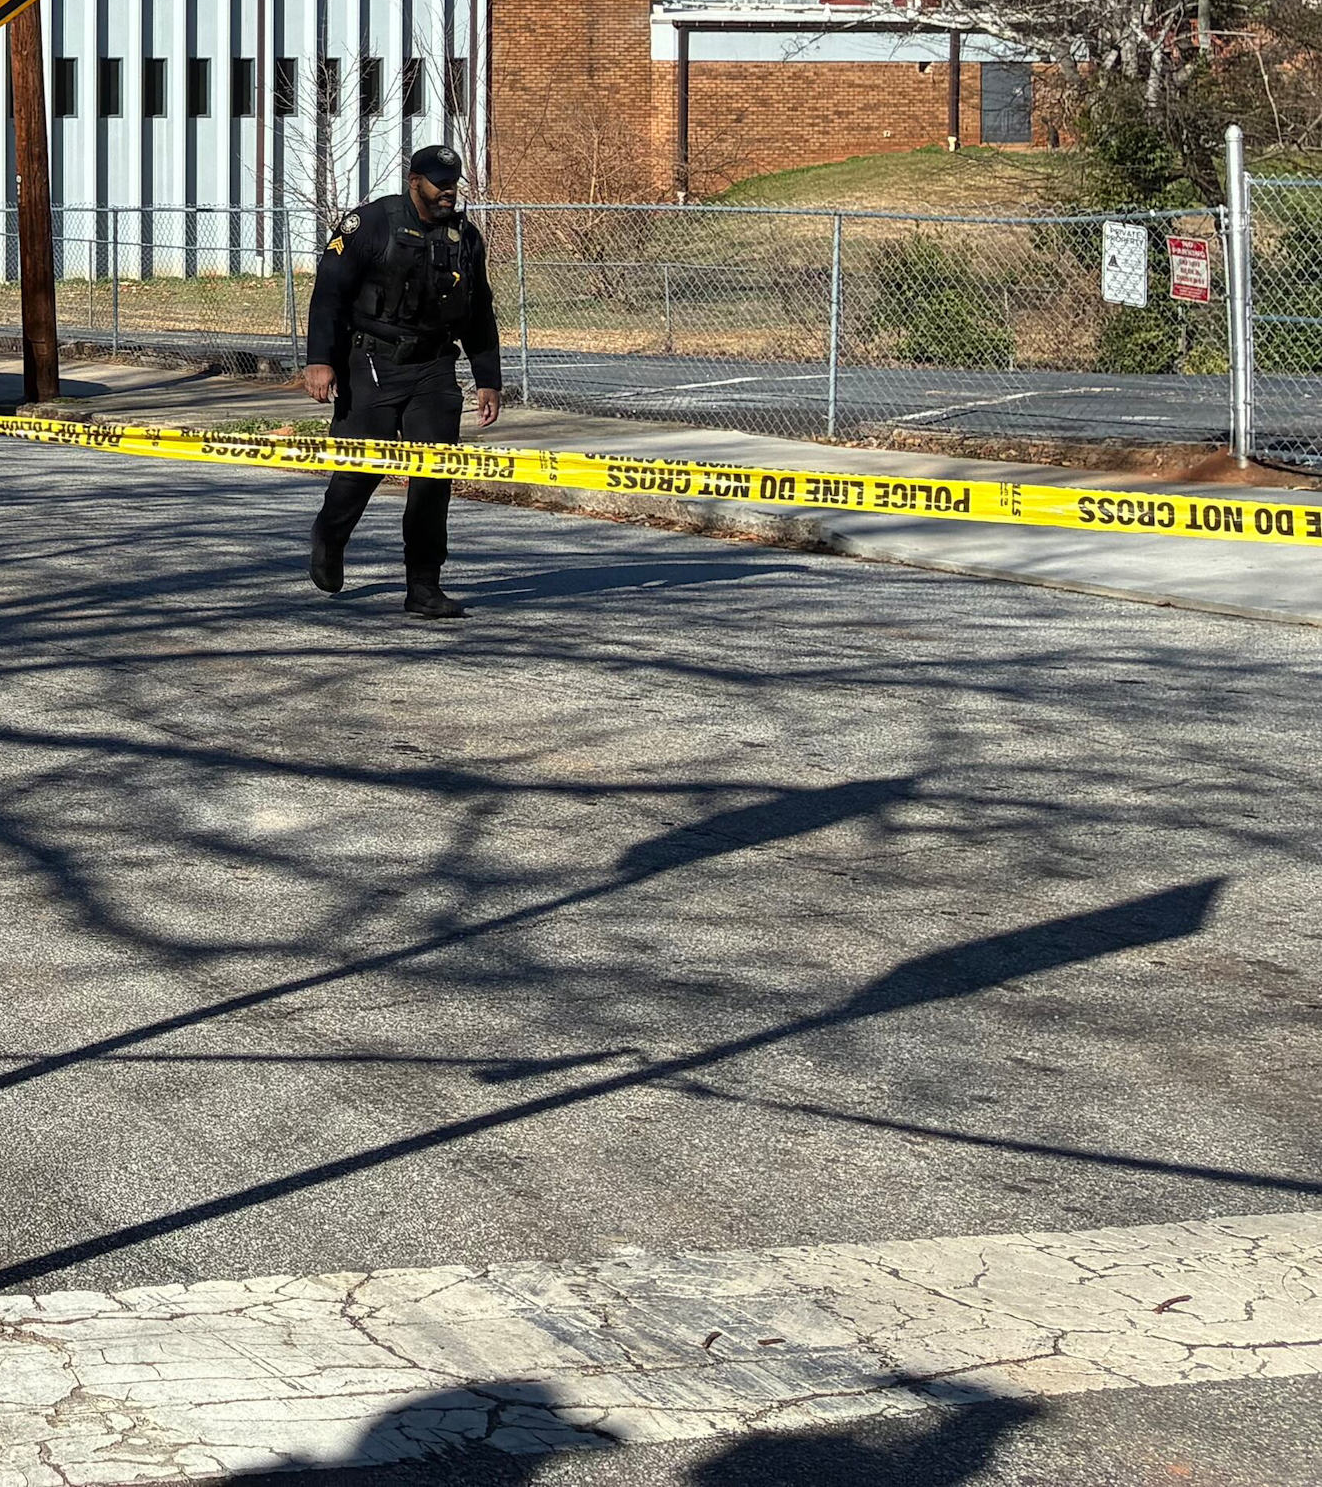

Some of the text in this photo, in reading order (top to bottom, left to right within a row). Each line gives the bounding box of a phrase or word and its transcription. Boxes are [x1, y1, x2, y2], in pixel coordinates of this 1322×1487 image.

[333, 445, 366, 468] DO
[372, 448, 424, 473] LINE
[431, 452, 515, 479] POLICE
[606, 464, 692, 495] CROSS
[698, 471, 751, 498] NOT
[760, 475, 796, 500] DO
[804, 478, 864, 506] LINE
[874, 482, 970, 513] POLICE
[1077, 496, 1175, 528] CROSS
[1185, 503, 1243, 533] NOT
[1254, 508, 1294, 537] DO
